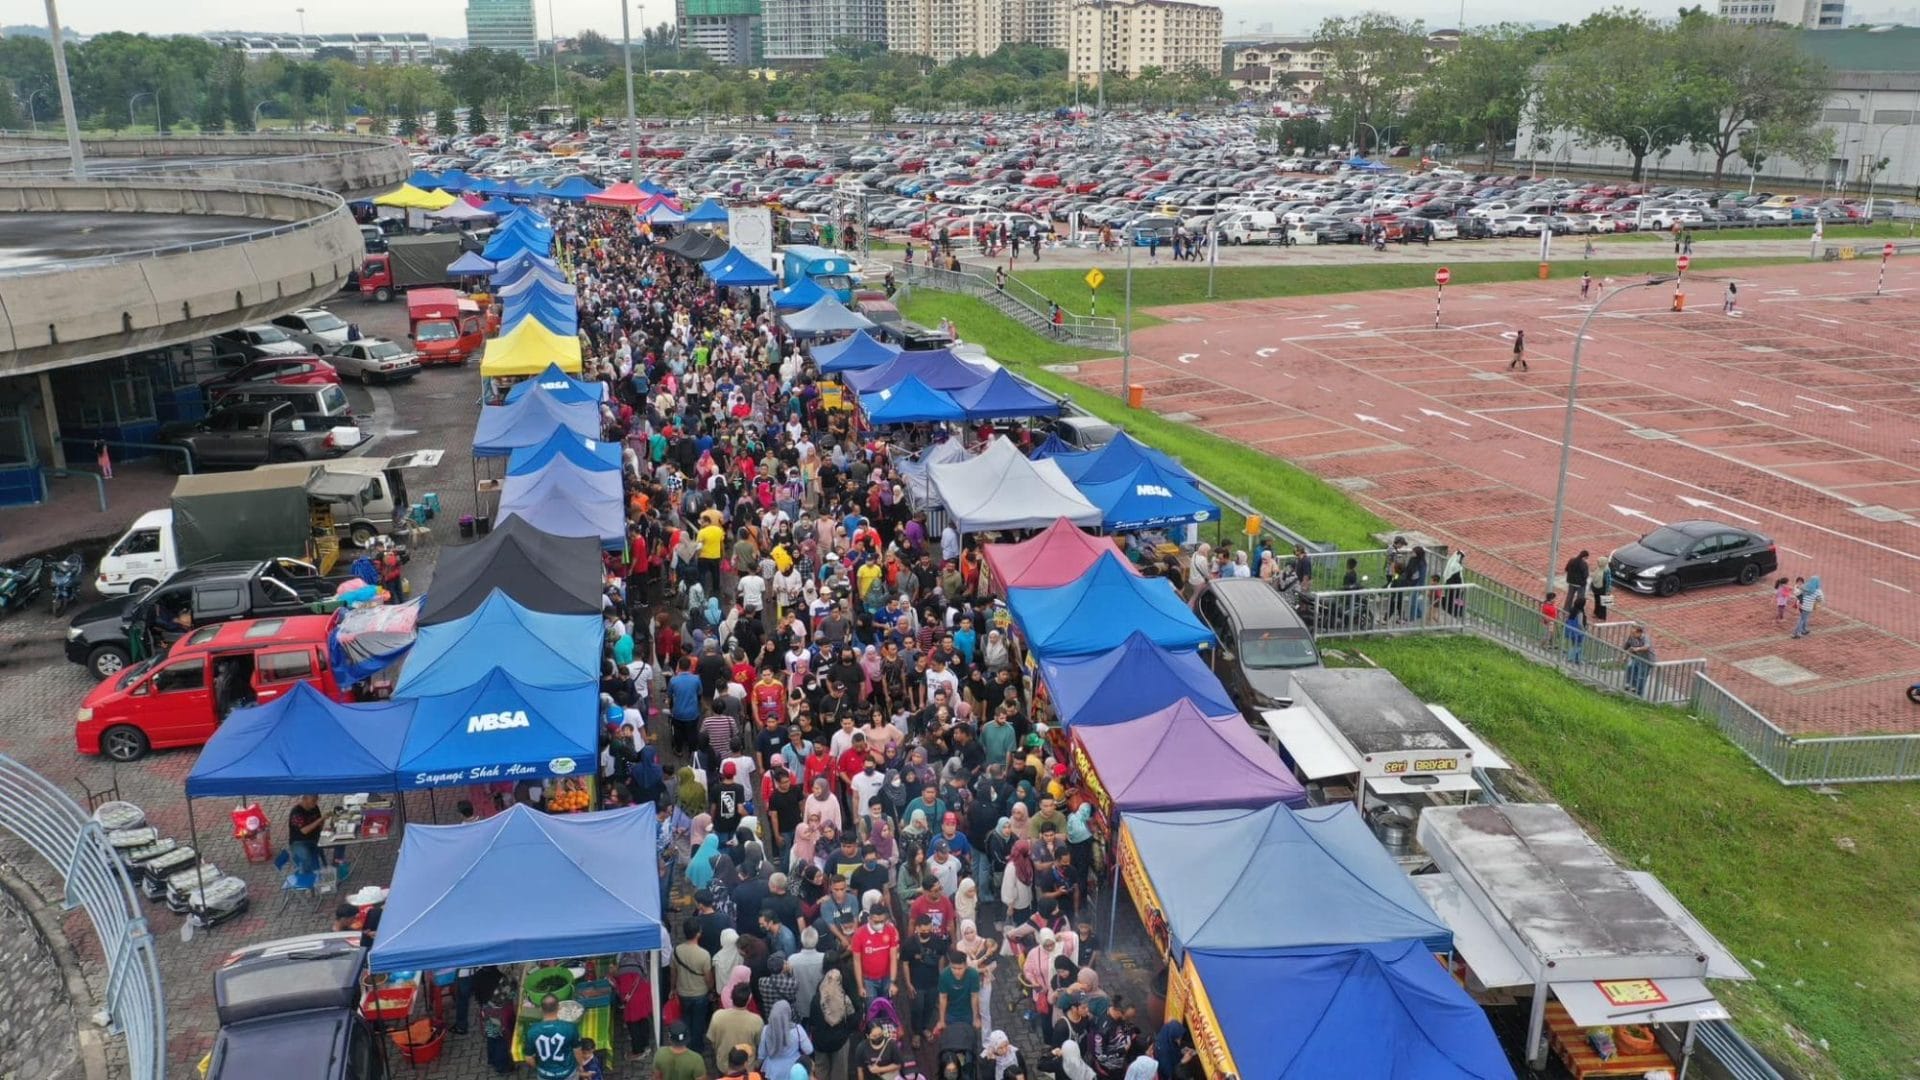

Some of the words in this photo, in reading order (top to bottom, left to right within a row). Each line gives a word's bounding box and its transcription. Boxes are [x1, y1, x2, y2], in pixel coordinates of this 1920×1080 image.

[1136, 484, 1173, 497] MBSA
[467, 710, 530, 733] MBSA
[415, 770, 463, 784] Sayangi
[469, 765, 500, 779] Shah
[504, 763, 537, 776] Alam
[535, 1032, 566, 1061] 02
